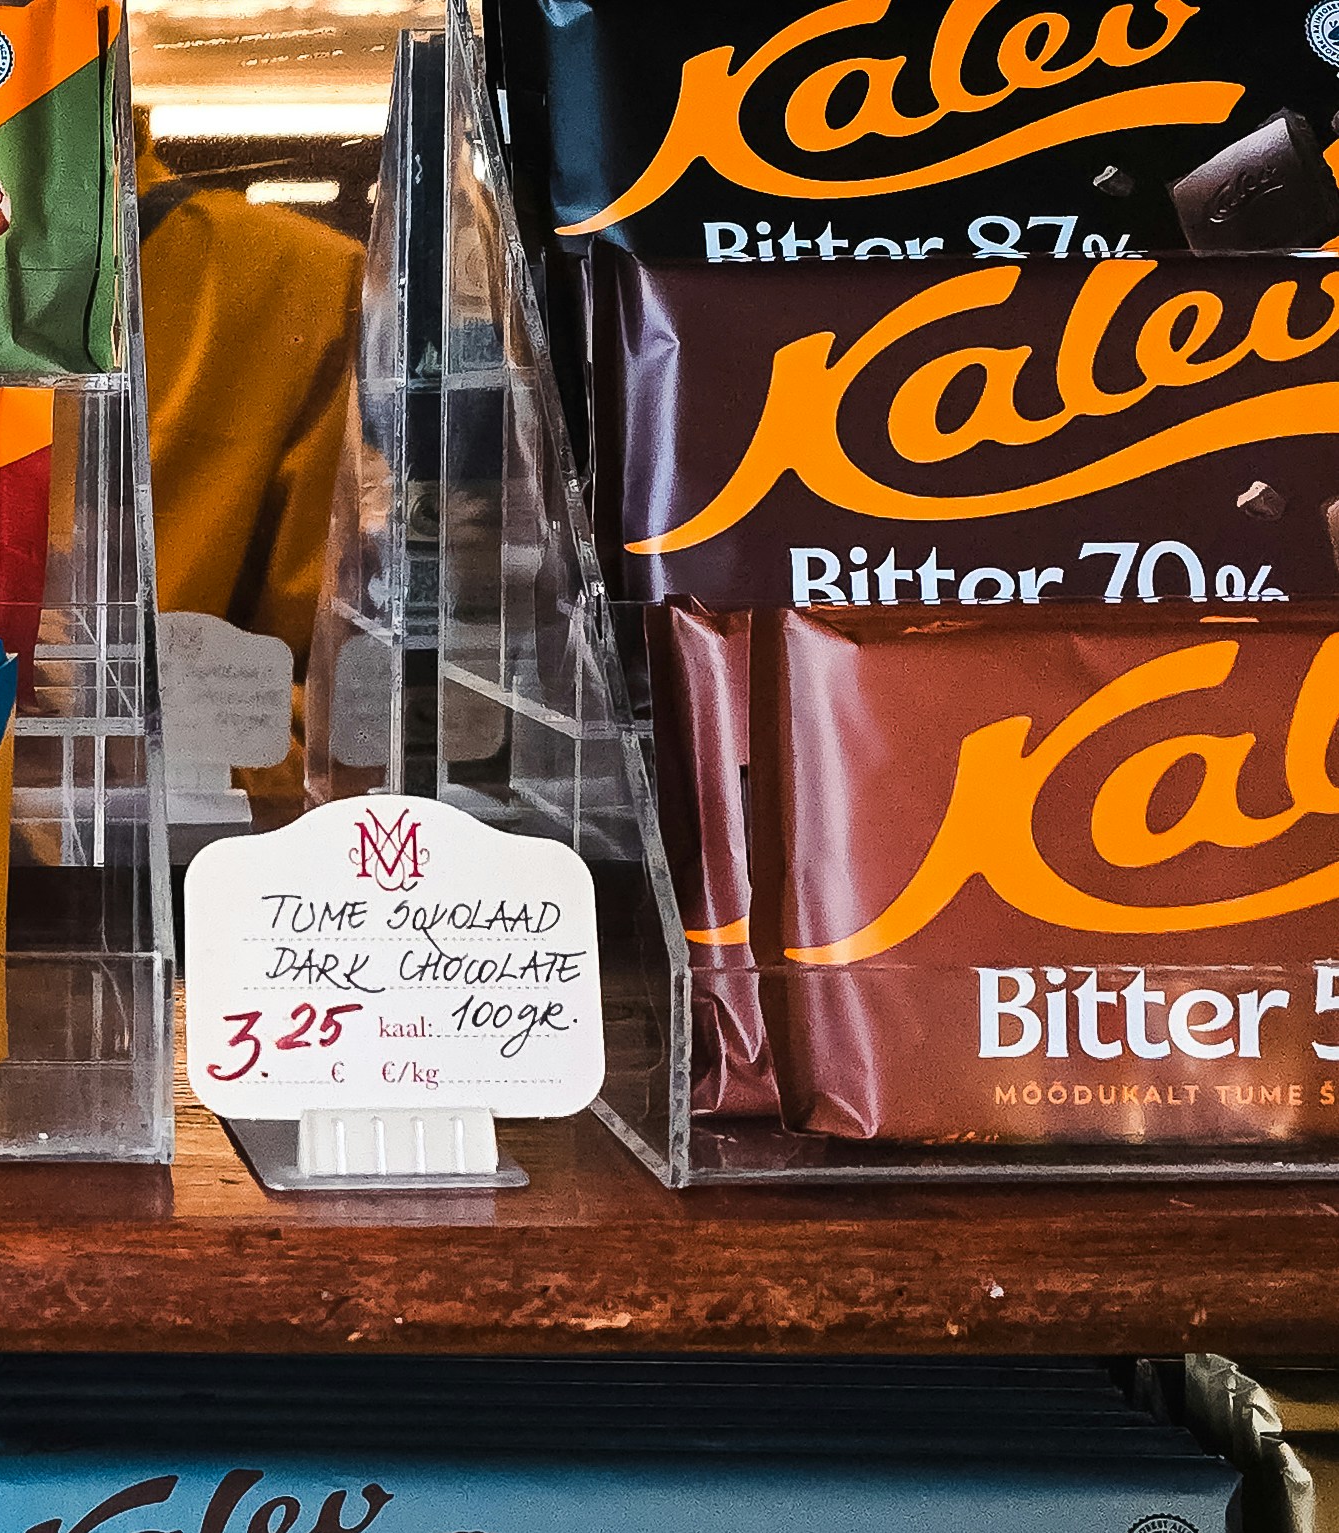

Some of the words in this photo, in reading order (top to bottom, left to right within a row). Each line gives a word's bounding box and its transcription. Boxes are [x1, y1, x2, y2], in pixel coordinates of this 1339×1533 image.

[554, 0, 1245, 236] Kalev
[262, 895, 368, 932] TUME
[266, 946, 385, 993] DARK
[399, 949, 587, 985] CHOCOLATE
[977, 967, 1290, 1060] Bitter
[382, 1061, 440, 1090] €/kg
[994, 1080, 1200, 1105] MÕÕDUKALT
[1216, 1084, 1304, 1105] TUME
